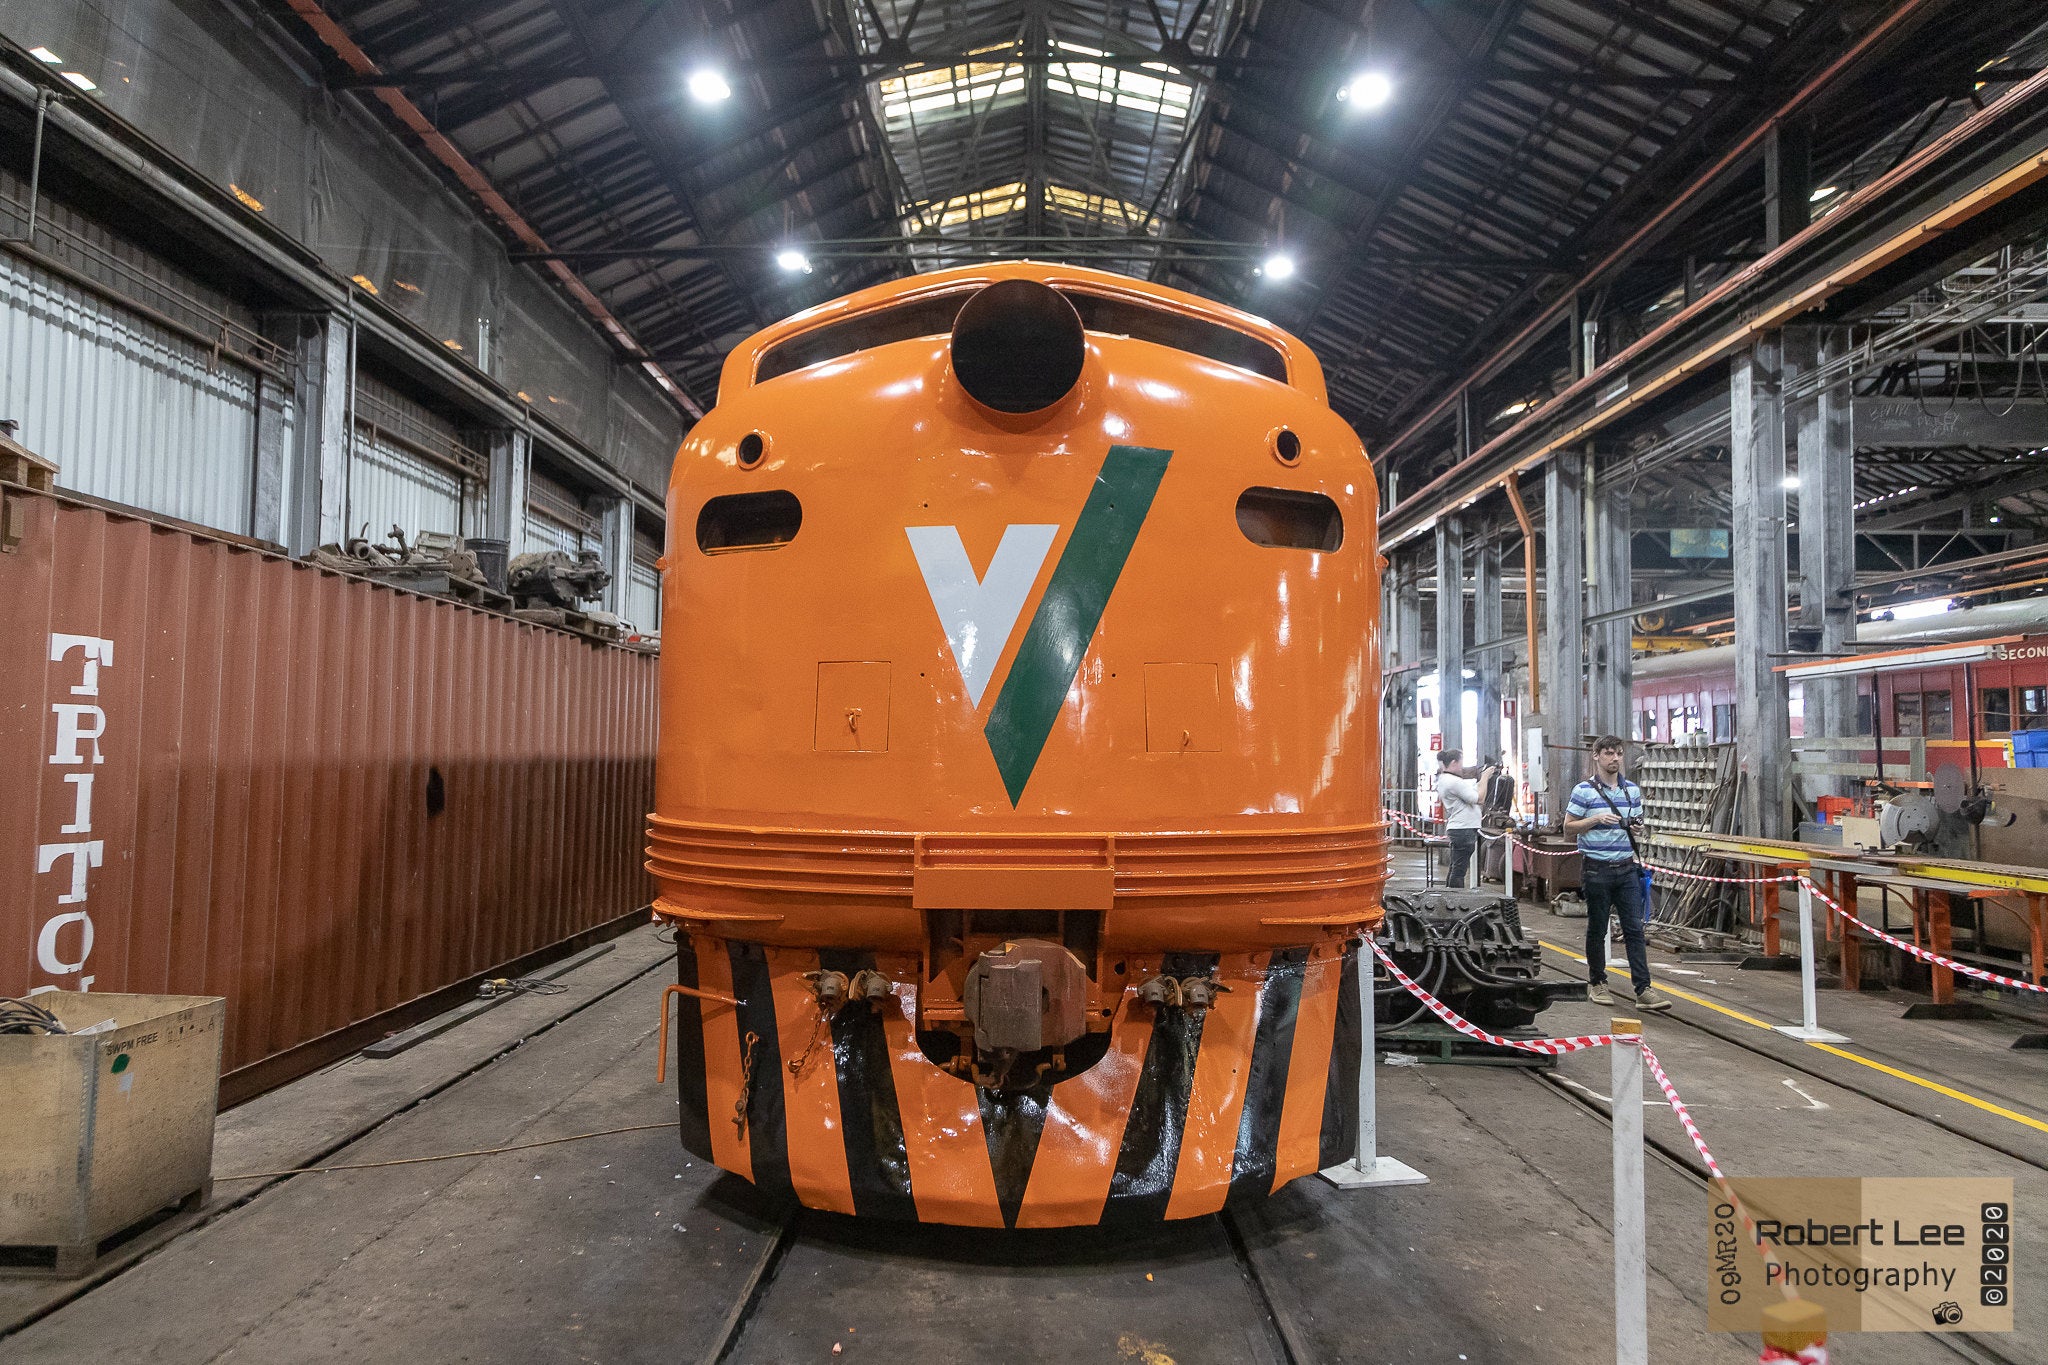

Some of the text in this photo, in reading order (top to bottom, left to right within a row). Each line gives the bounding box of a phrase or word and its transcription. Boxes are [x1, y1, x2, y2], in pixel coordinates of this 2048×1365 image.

[2000, 645, 2048, 660] SECON
[30, 632, 114, 993] TRITO
[135, 1031, 159, 1047] FREE
